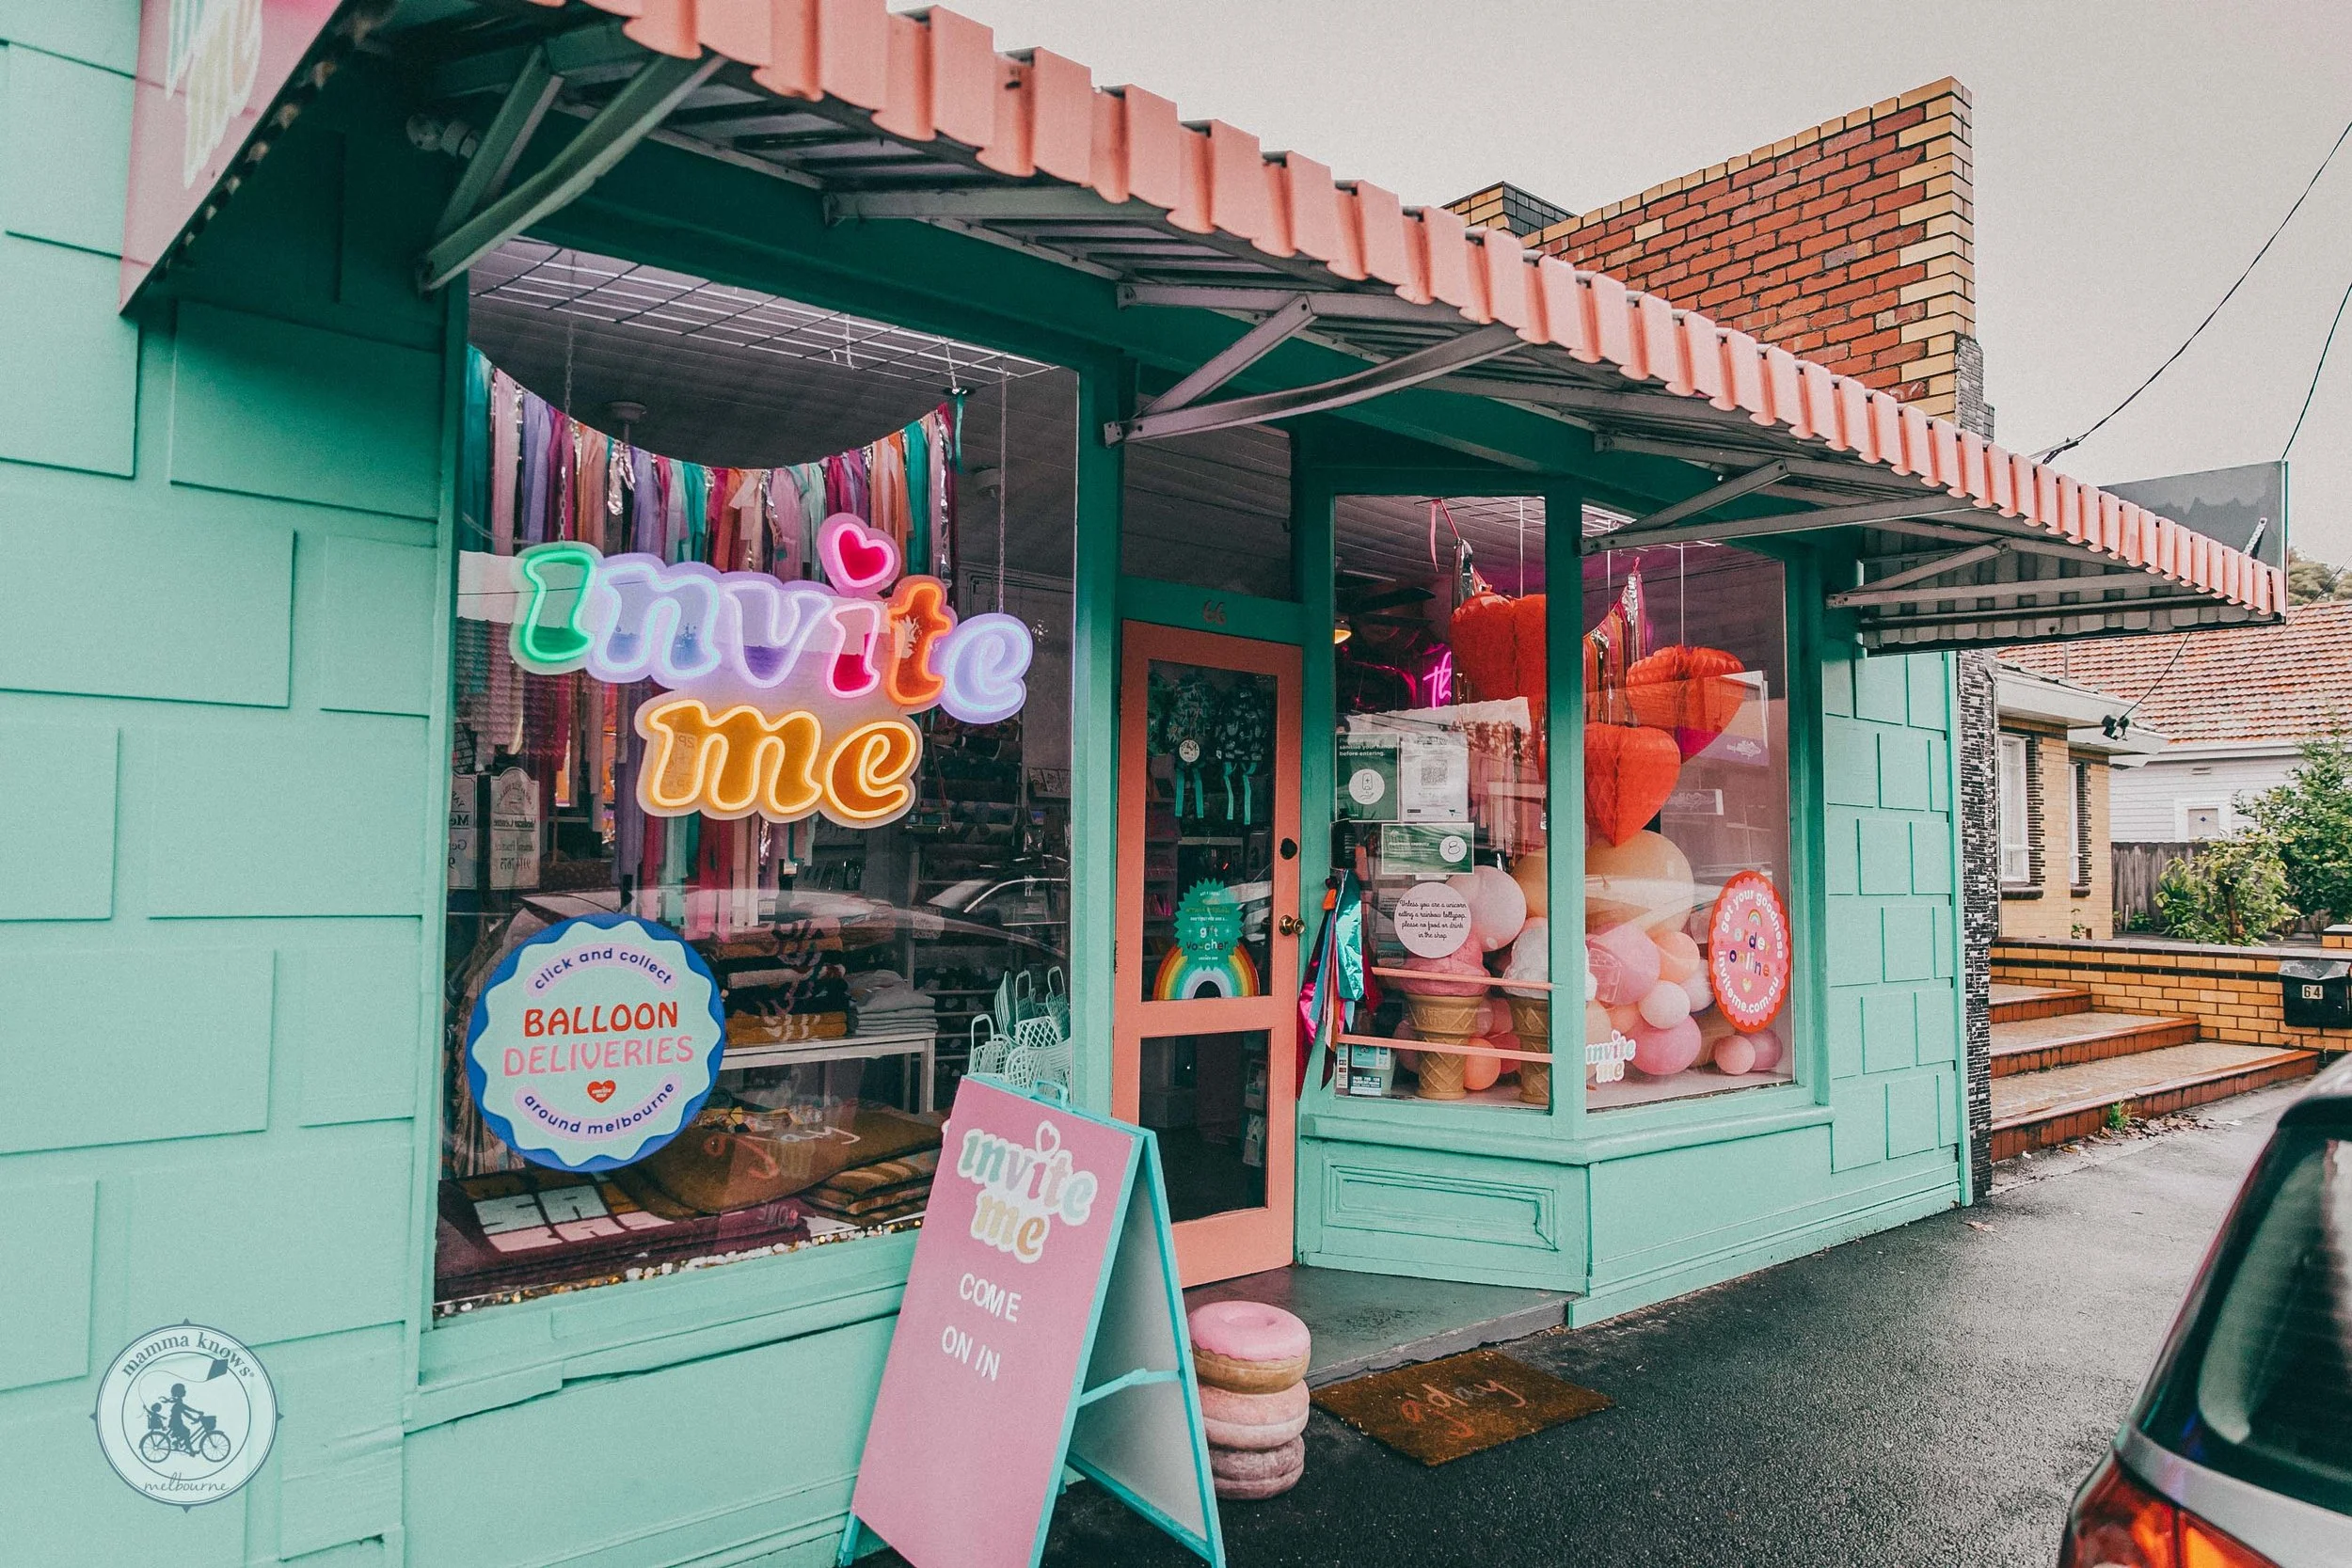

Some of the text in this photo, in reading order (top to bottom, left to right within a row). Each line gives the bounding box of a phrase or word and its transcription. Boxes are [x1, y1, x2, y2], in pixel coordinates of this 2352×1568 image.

[644, 695, 919, 821] me
[1447, 840, 1461, 855] 8
[1398, 911, 1414, 920] eating
[1399, 899, 1419, 908] Unless
[1420, 902, 1430, 911] you
[1721, 889, 1784, 959] get your goodness
[1401, 920, 1419, 930] please
[1427, 921, 1440, 931] food
[1433, 932, 1447, 942] shop
[1734, 927, 1771, 956] order
[534, 947, 673, 990] click and collect
[1718, 950, 1780, 1014] inviteme.com.au
[1728, 949, 1771, 977] online
[2302, 985, 2322, 998] 64
[523, 1001, 678, 1037] BALLOON
[502, 1035, 694, 1077] DELIVERIES
[523, 1082, 675, 1135] around melbourne
[972, 1192, 1048, 1259] me
[958, 1272, 1023, 1323] COME
[941, 1324, 1001, 1382] ON IN
